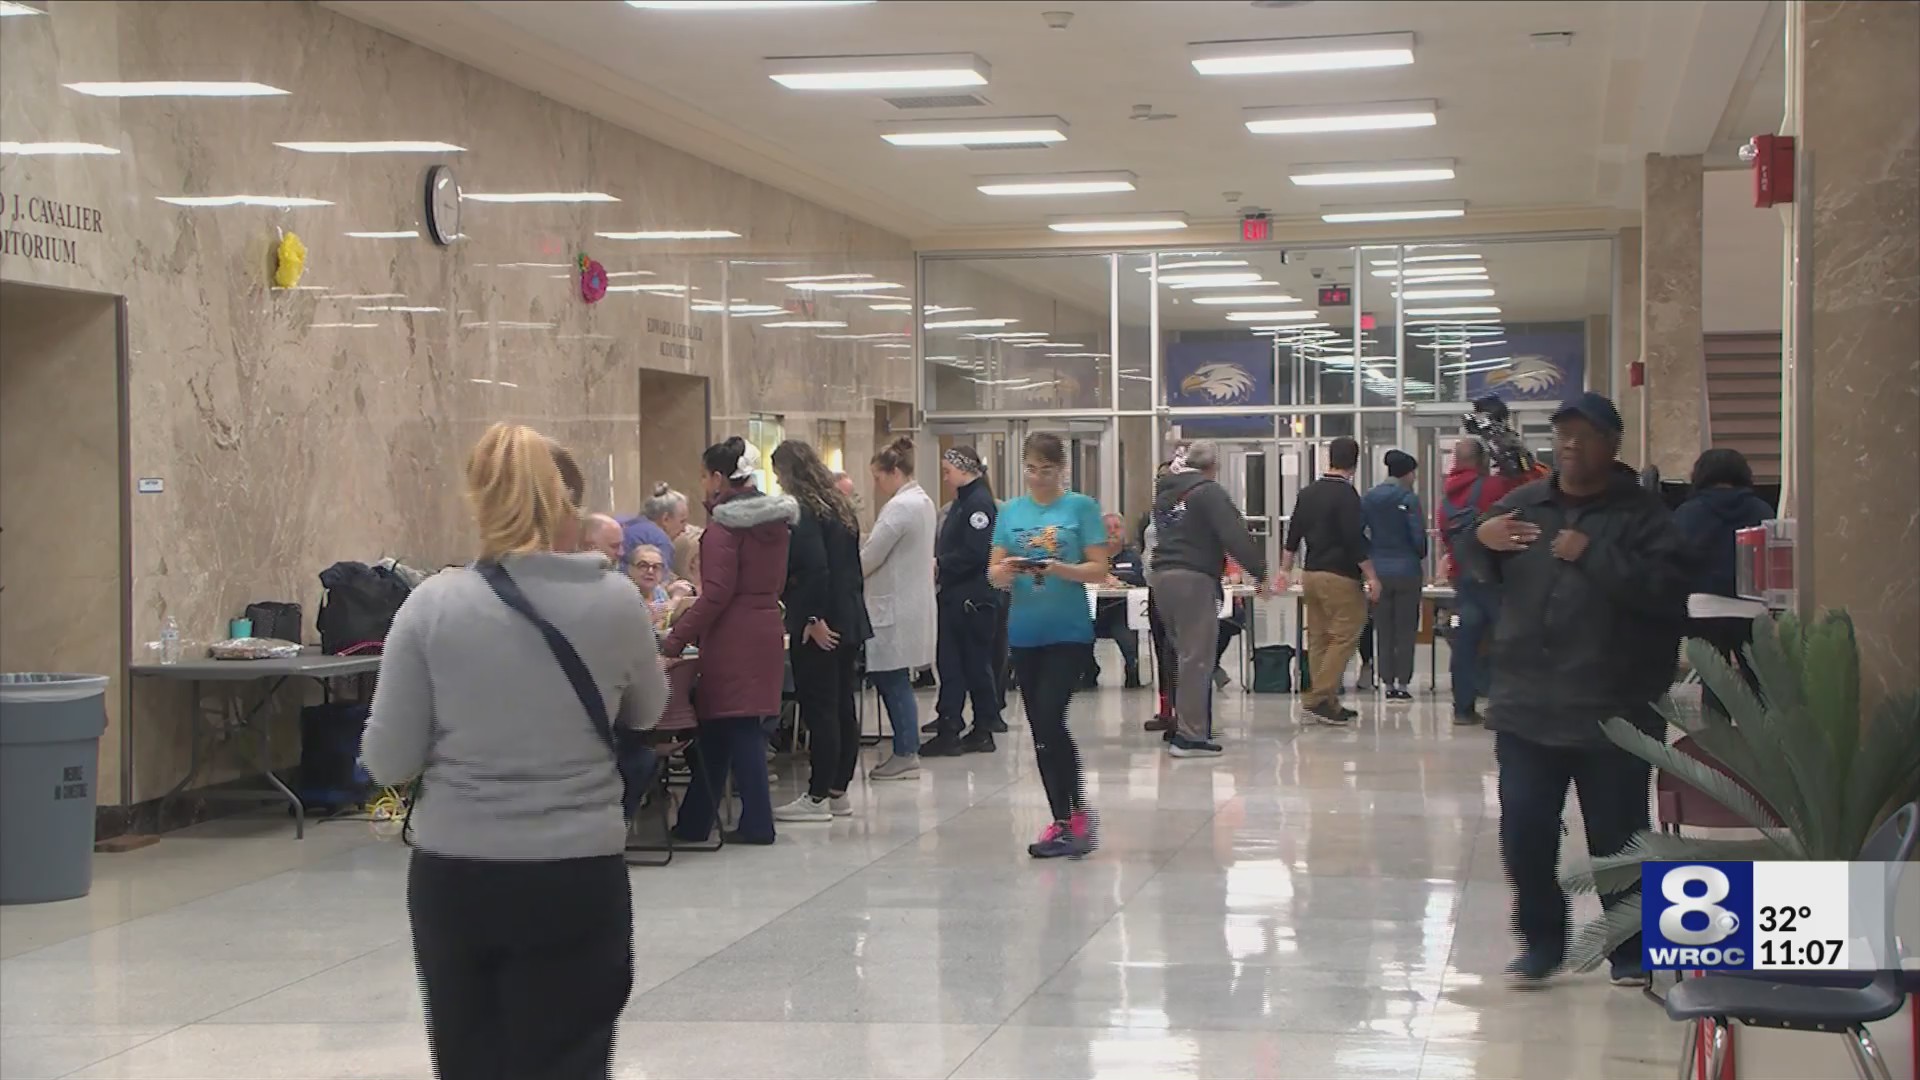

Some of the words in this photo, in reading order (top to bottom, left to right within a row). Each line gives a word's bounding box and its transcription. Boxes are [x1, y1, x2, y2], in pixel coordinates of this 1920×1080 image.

[11, 194, 25, 222] J.
[29, 197, 103, 233] CAVALIER
[1242, 219, 1269, 240] EXIT
